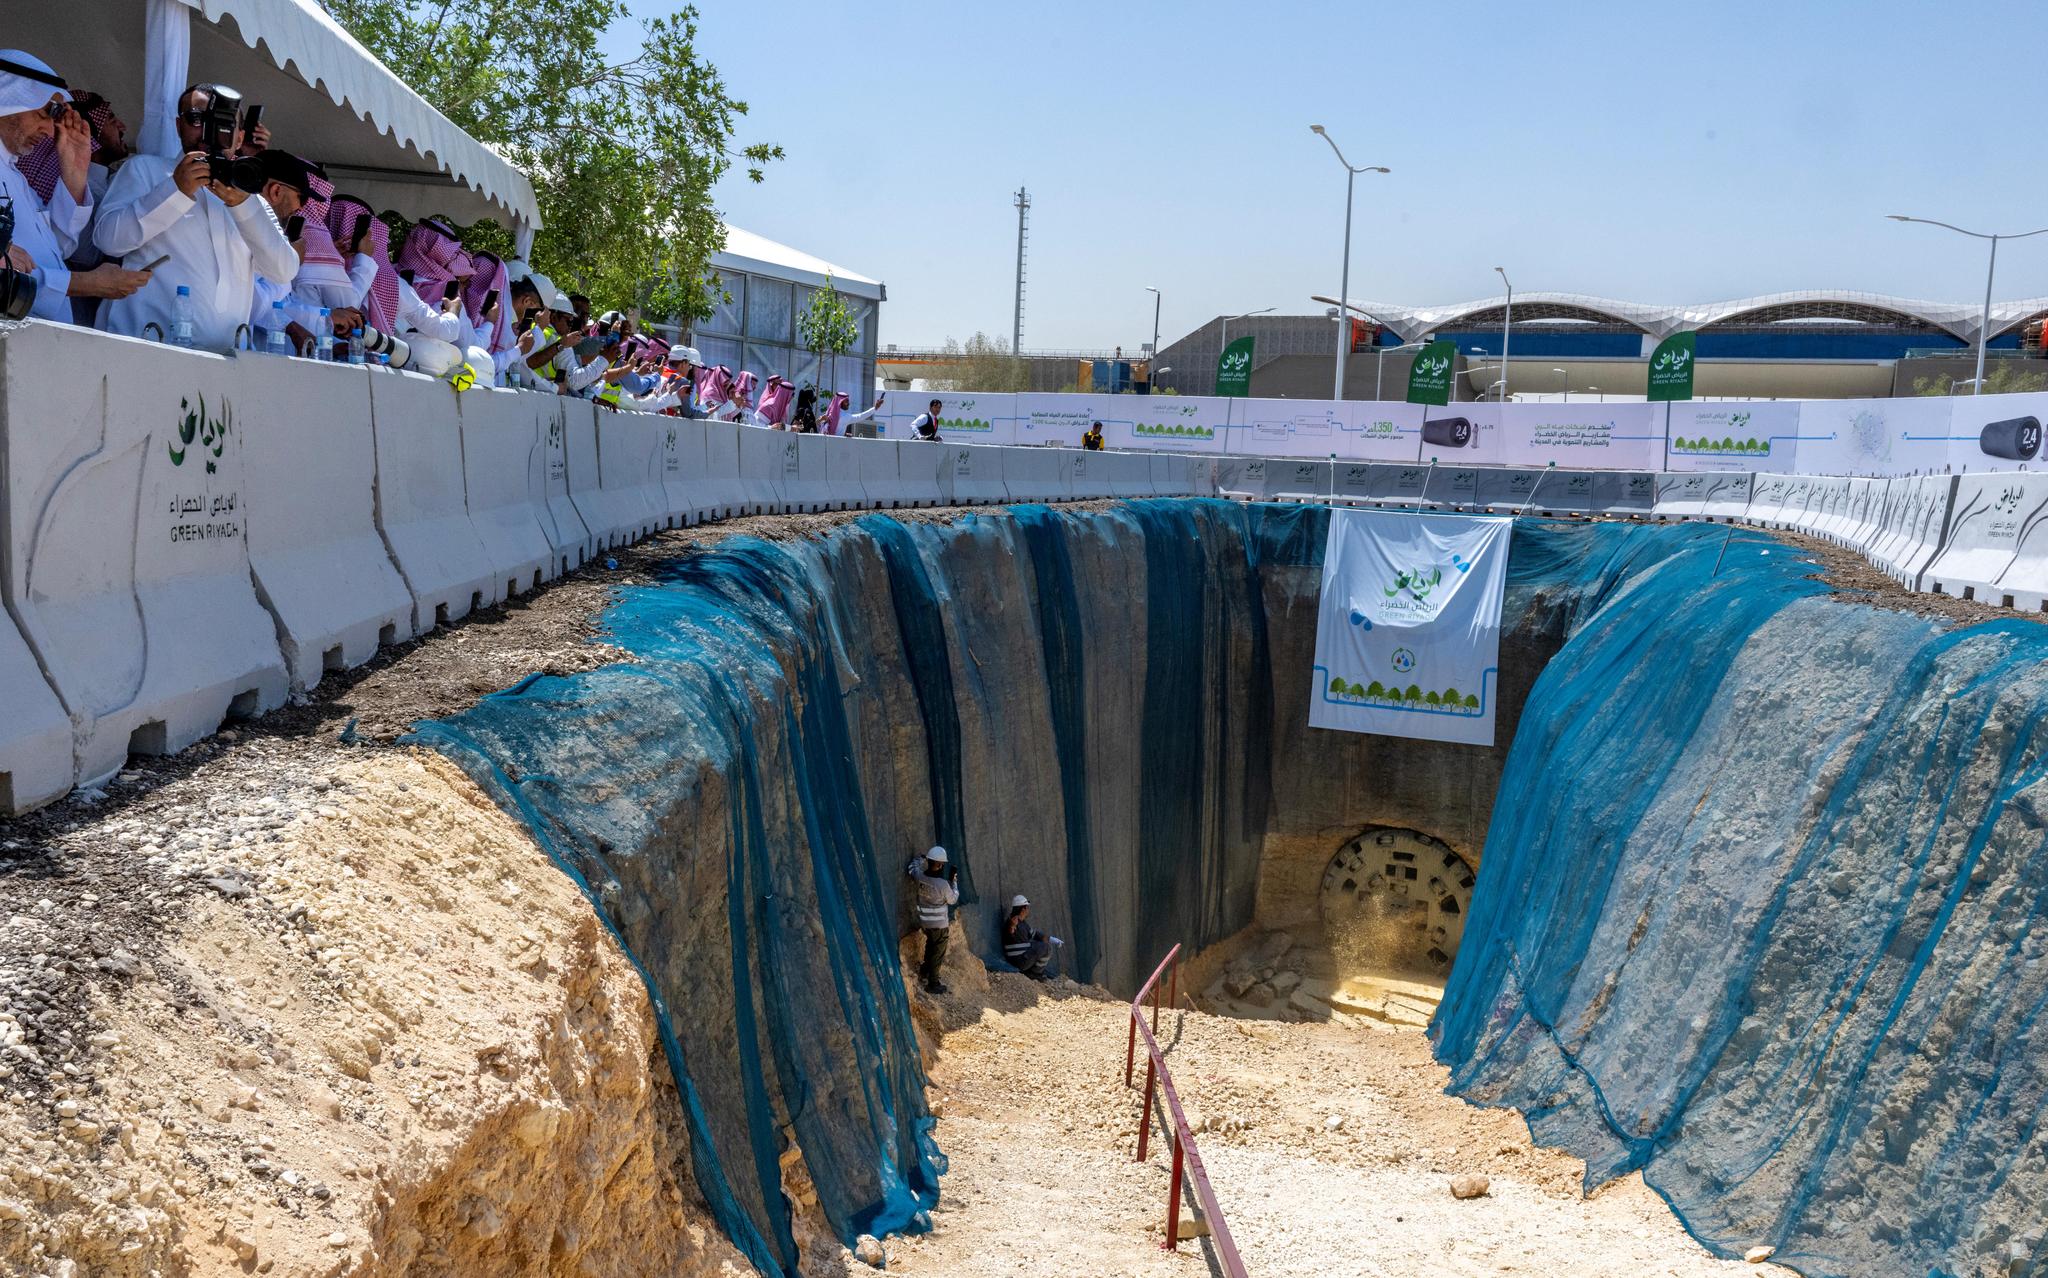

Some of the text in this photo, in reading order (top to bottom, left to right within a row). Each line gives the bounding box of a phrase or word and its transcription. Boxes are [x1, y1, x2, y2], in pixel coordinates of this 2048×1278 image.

[2022, 428, 2037, 444] 2.4
[1384, 567, 1442, 601] الرياض
[1380, 600, 1438, 613] الرياض الخضراء
[1378, 611, 1405, 619] GREEN
